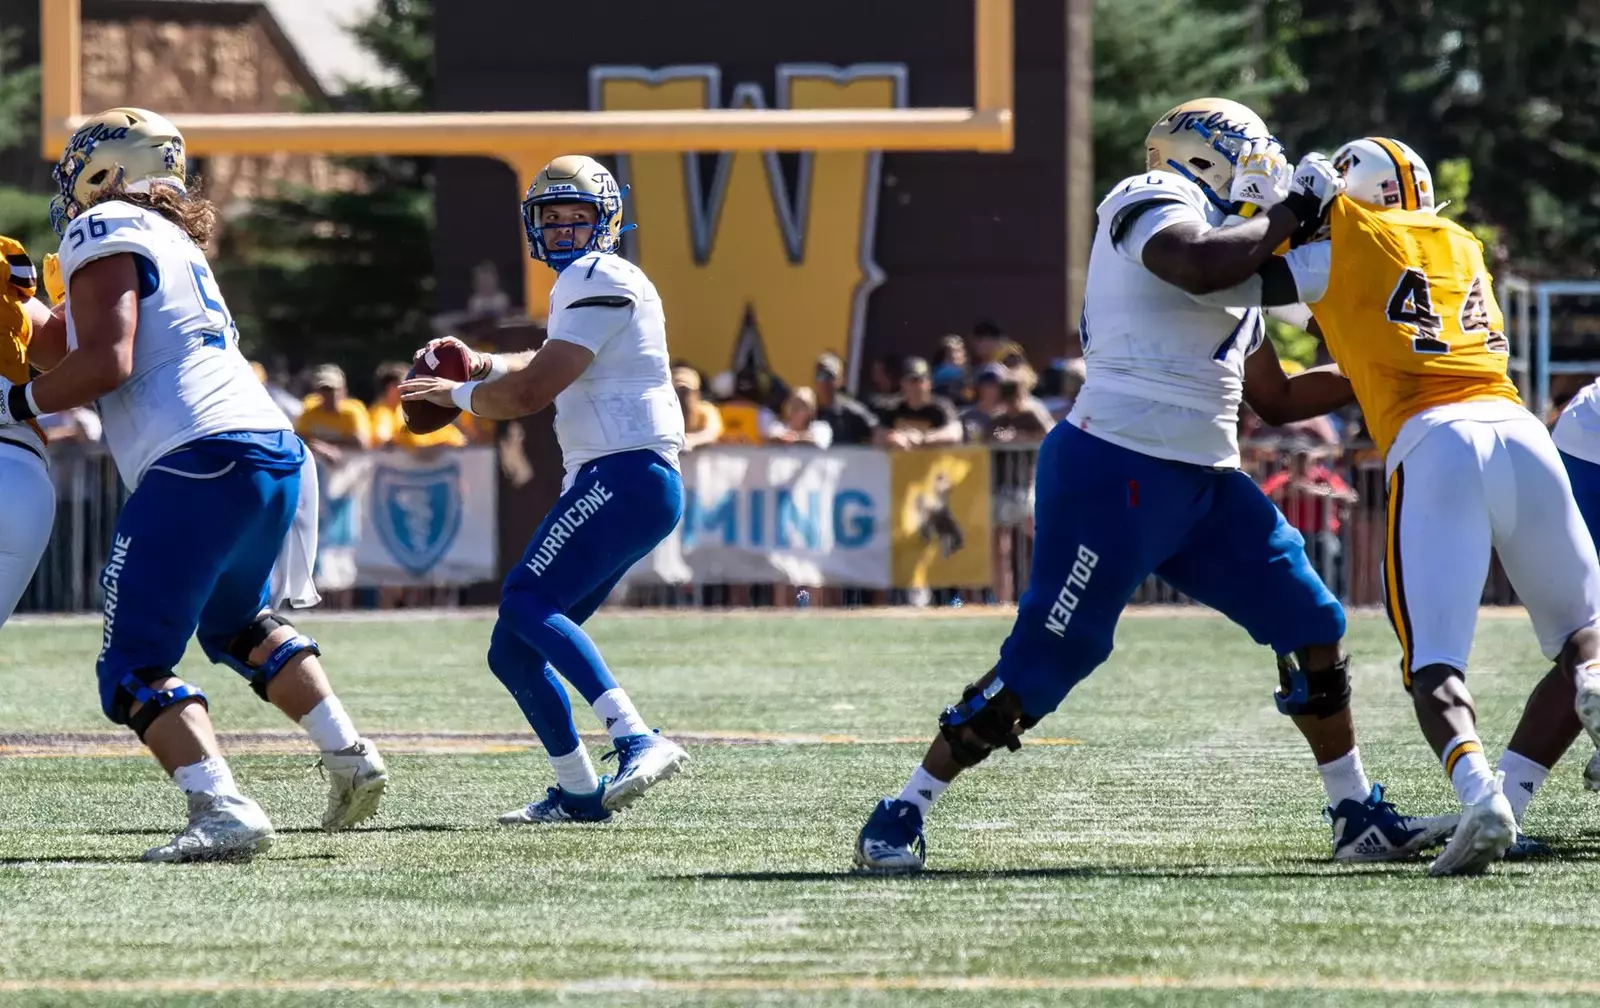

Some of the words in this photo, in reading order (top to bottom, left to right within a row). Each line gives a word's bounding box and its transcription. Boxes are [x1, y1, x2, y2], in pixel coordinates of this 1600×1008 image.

[65, 122, 129, 152] Tulsa
[1169, 110, 1248, 135] Tulsa
[548, 184, 573, 193] TULSA
[68, 212, 108, 250] 56
[588, 64, 910, 398] W
[585, 256, 601, 281] 7
[1385, 266, 1510, 356] 44
[525, 479, 614, 578] HURRICANE
[1044, 543, 1100, 638] GOLDEN
